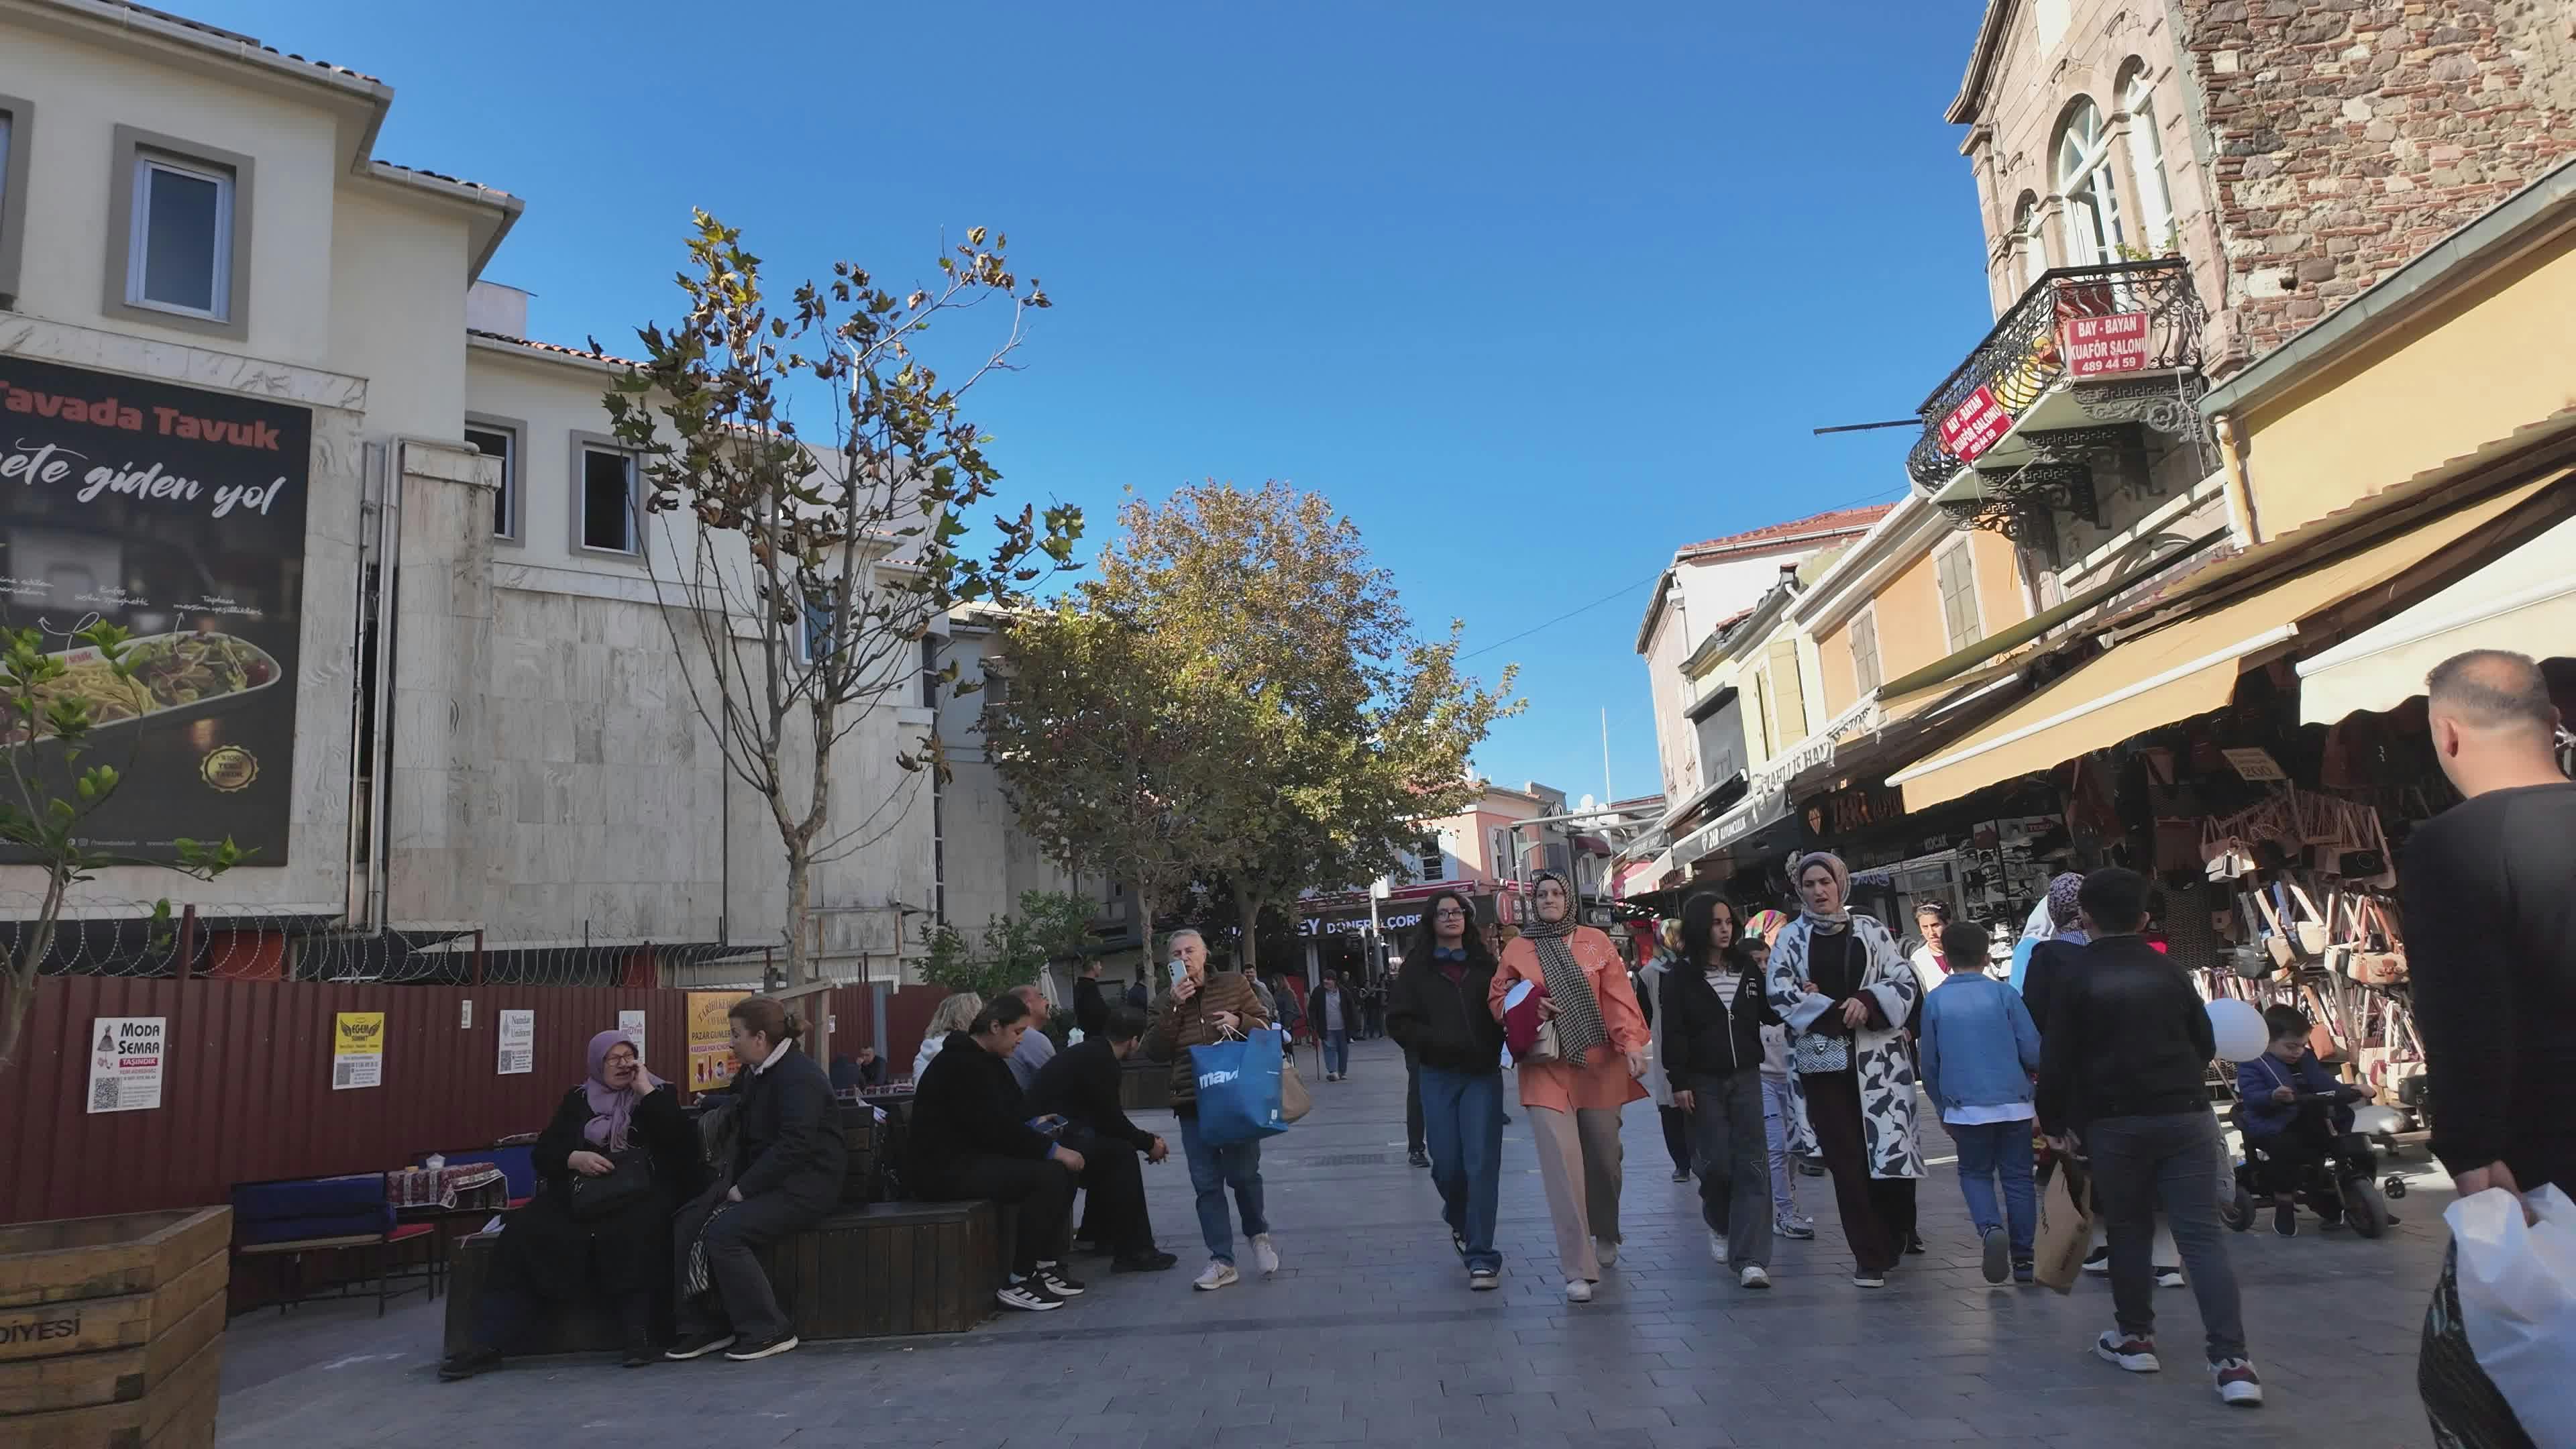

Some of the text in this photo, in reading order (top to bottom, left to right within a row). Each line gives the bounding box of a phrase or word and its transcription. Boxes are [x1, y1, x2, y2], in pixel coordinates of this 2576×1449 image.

[2078, 321, 2097, 337] BAY
[2105, 316, 2137, 334] BAYAN
[2070, 337, 2147, 360] KUAFÖR SALONU
[2082, 357, 2137, 372] 489 44 59
[1946, 415, 1961, 435] BAY
[1960, 394, 1984, 421] BAYAN
[154, 405, 280, 451] Tavuk
[1951, 404, 2002, 453] KUAFÖR SALONU
[0, 437, 287, 519] ete giden yol
[120, 1022, 160, 1037] MODA
[692, 1031, 710, 1040] PAZAR
[117, 1040, 160, 1055] SEMRA
